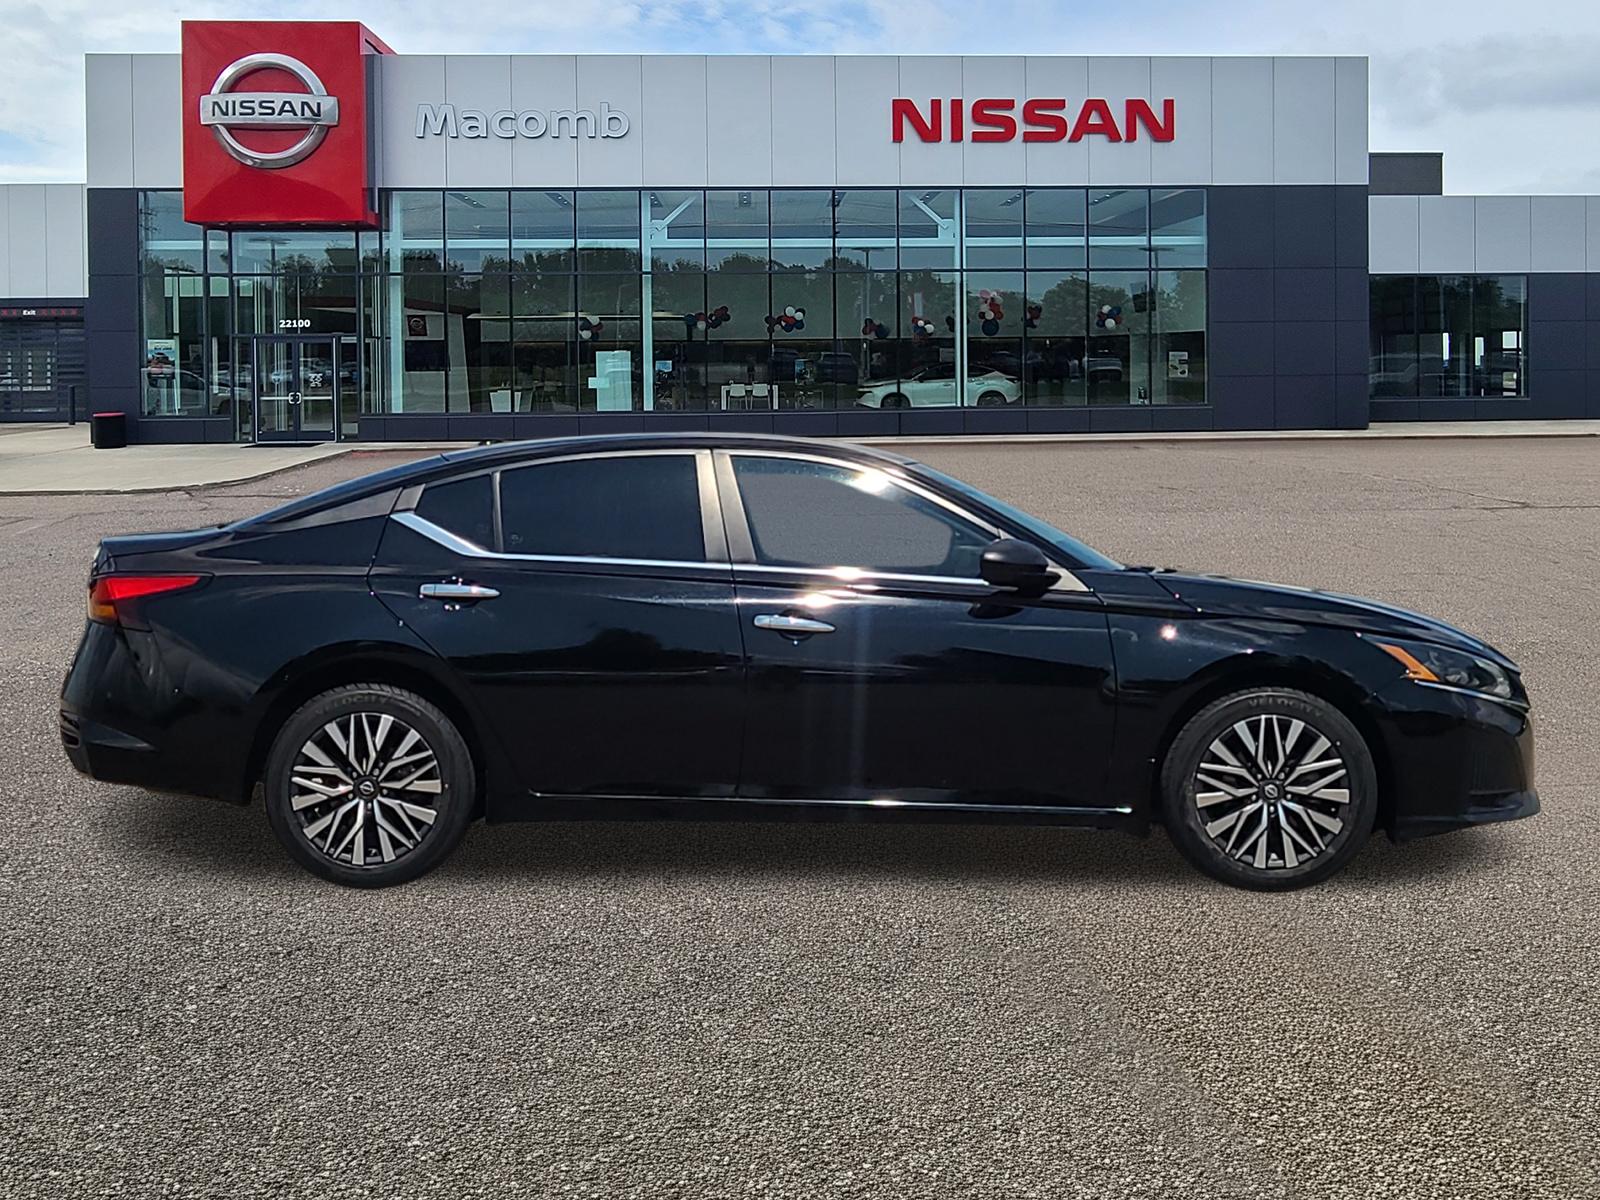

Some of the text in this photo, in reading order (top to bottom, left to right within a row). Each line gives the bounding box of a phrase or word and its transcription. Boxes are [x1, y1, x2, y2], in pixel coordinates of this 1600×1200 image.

[212, 100, 322, 118] NISSAN
[415, 102, 630, 138] Macomb
[892, 98, 1175, 143] NISSAN
[279, 319, 311, 328] 22100
